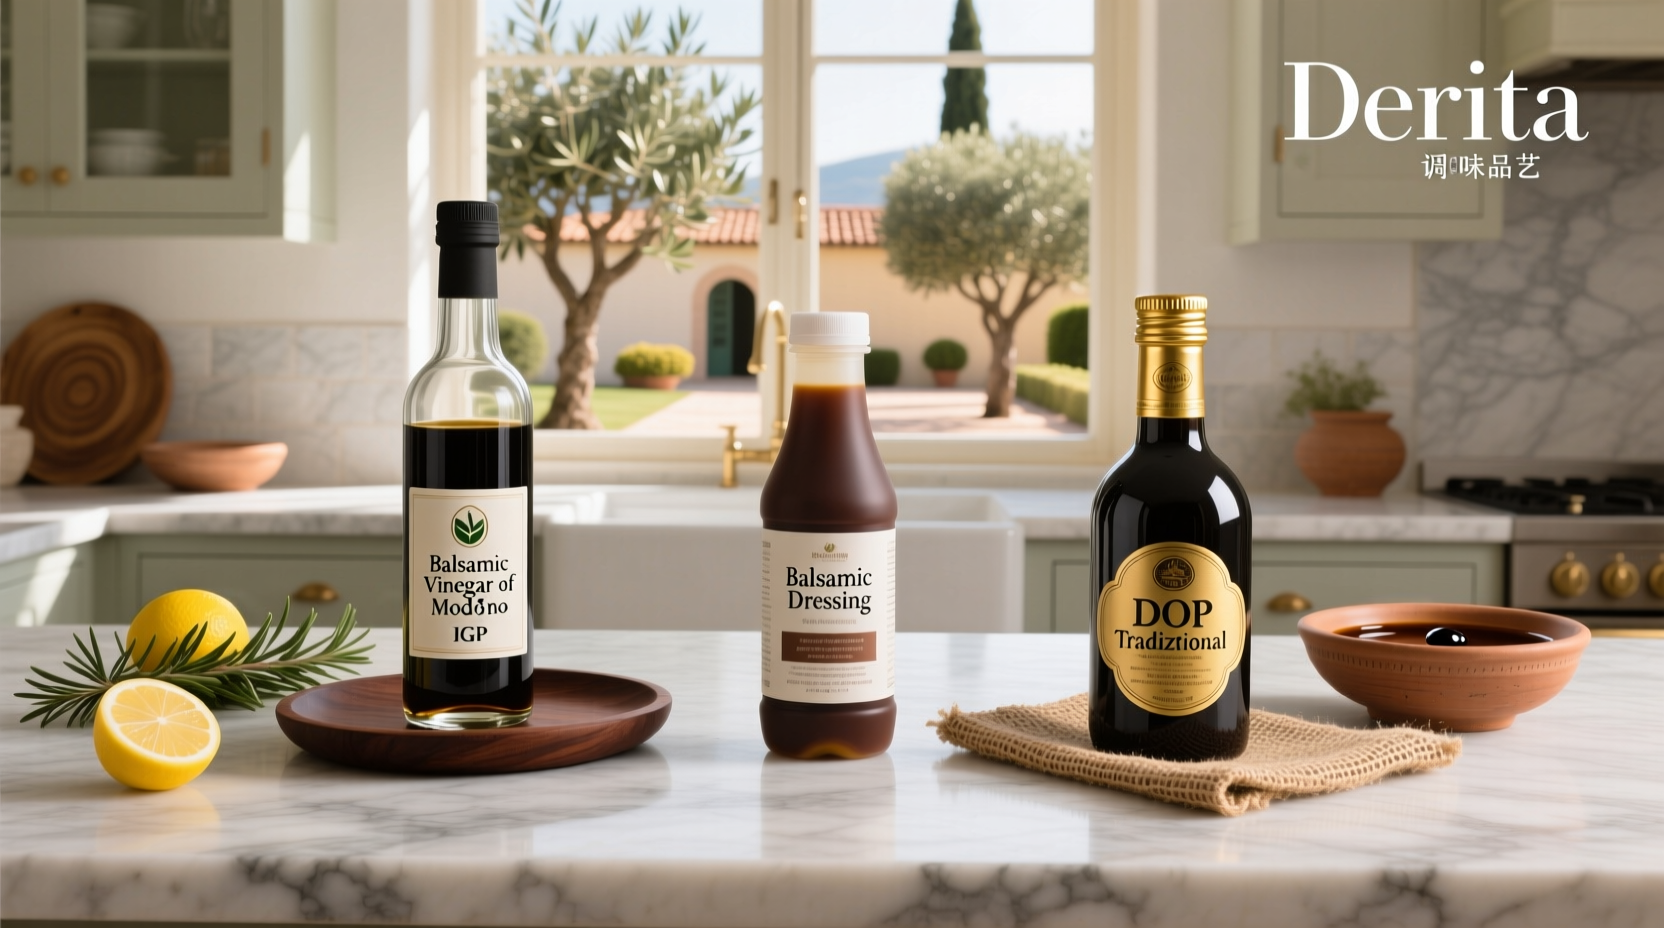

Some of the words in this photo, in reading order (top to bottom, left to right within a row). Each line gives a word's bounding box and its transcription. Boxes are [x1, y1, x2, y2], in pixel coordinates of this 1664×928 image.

[430, 554, 508, 573] Balsamic
[424, 576, 494, 598] Vinegar
[499, 573, 516, 592] of
[786, 566, 872, 587] Balsamic
[788, 590, 872, 615] Dressing
[1133, 598, 1213, 628] DOP
[453, 626, 488, 642] IGP
